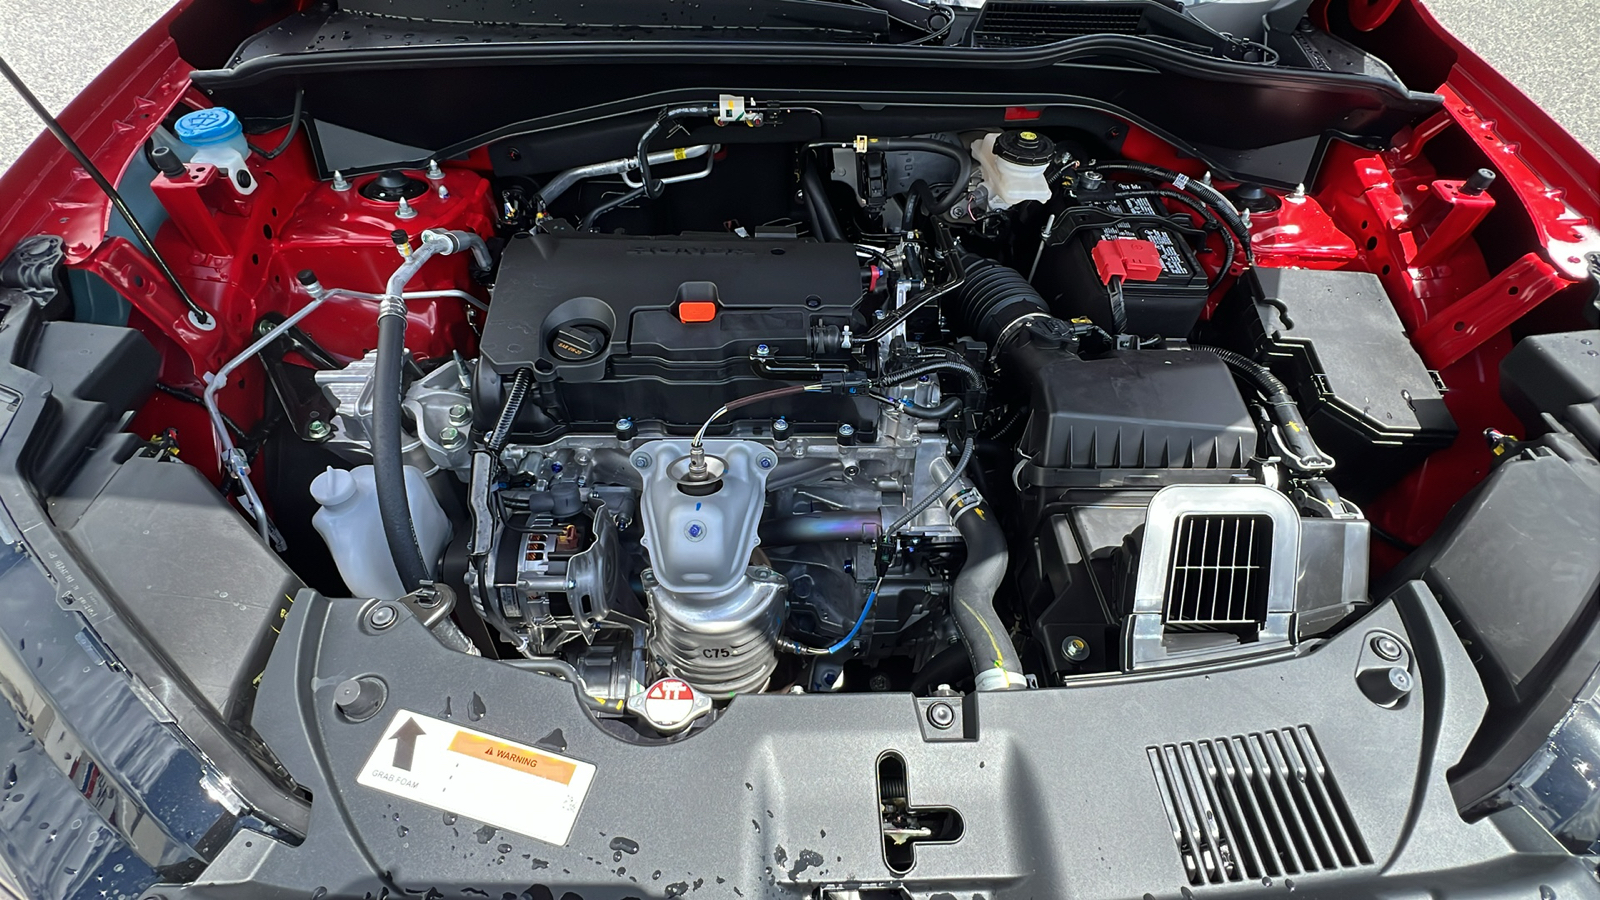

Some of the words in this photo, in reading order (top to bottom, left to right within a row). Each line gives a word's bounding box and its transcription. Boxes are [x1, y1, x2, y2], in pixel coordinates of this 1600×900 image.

[703, 648, 730, 659] C75
[497, 750, 538, 768] WARNING
[372, 769, 394, 783] GRAB
[396, 776, 419, 789] FOAM
